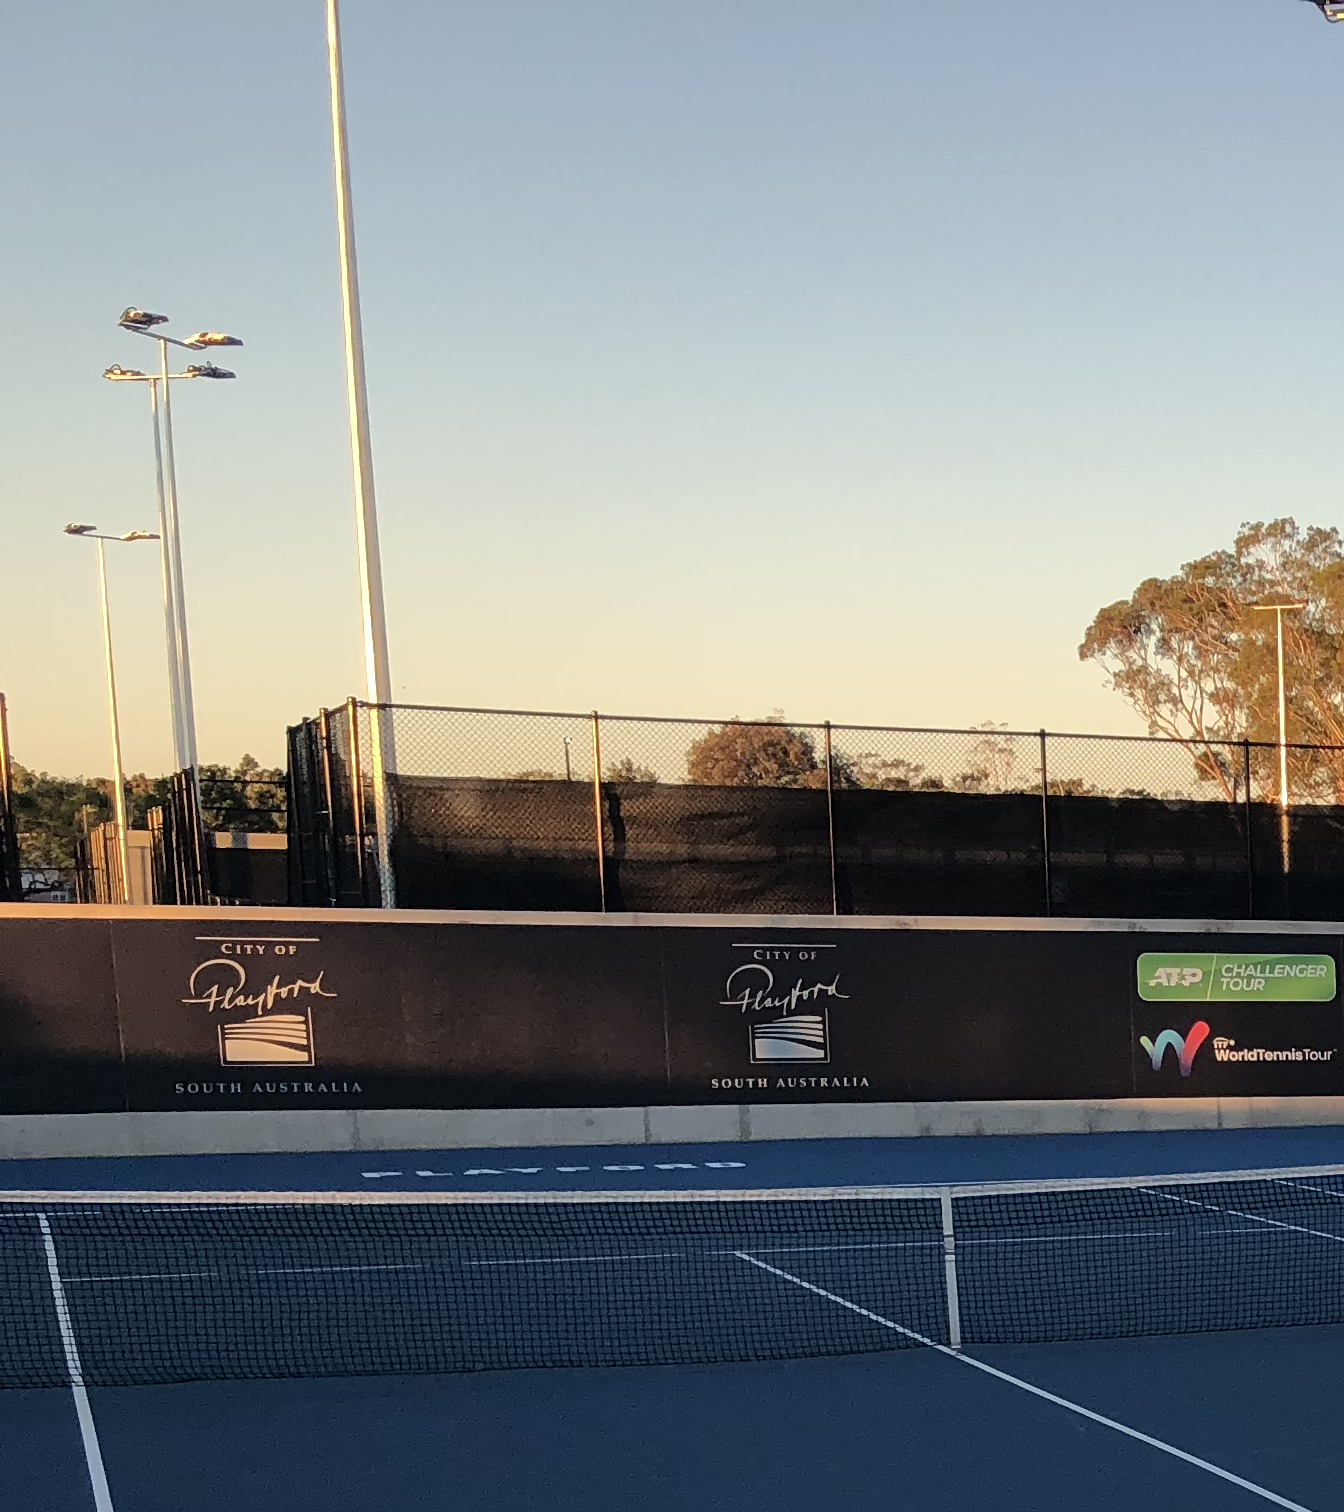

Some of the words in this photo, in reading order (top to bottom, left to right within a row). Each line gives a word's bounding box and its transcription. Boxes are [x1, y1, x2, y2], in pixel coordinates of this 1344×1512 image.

[221, 943, 265, 955] CITY
[274, 945, 297, 956] OF
[753, 949, 791, 960] CITY
[799, 951, 817, 960] OF
[1146, 967, 1203, 987] ATP
[1221, 963, 1327, 979] CHALLENGER
[182, 958, 338, 1014] Playford
[719, 963, 850, 1015] Playford
[1221, 977, 1265, 991] TOUR
[1214, 1048, 1333, 1061] WorldTennisTour
[175, 1082, 242, 1095] SOUTH
[252, 1081, 363, 1094] AUSTRALIA
[711, 1077, 768, 1089] SOUTH
[776, 1076, 870, 1088] AUSTRALIA
[361, 1161, 747, 1178] PLAYFORD
